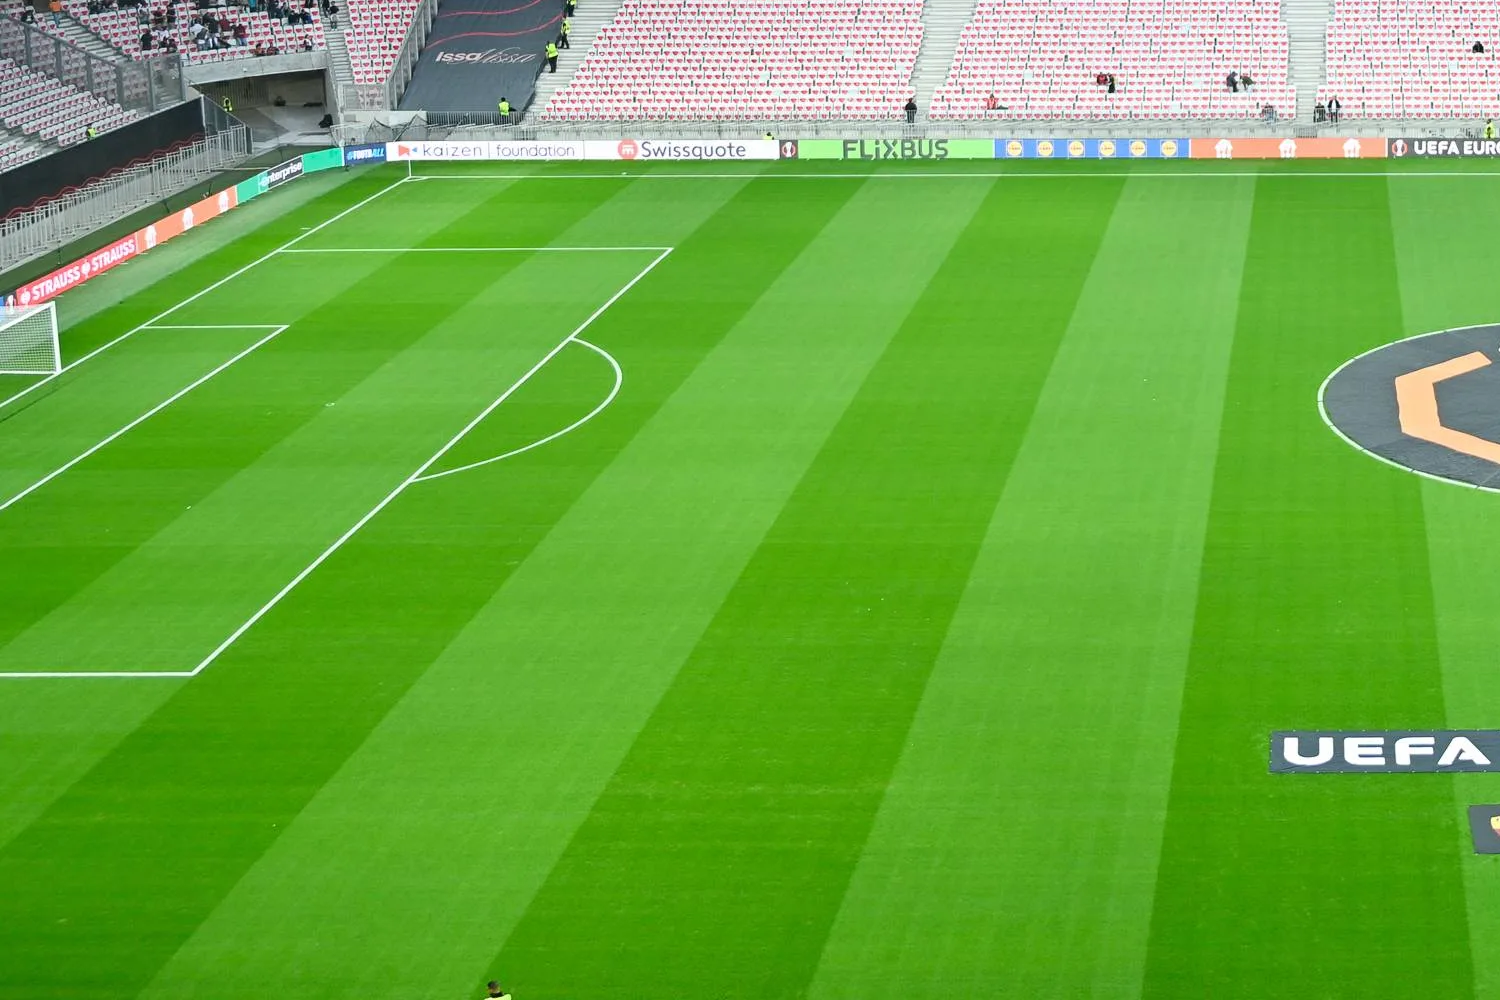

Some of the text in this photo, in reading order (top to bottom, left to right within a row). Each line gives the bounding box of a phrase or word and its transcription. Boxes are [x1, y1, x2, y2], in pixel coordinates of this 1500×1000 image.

[423, 143, 574, 158] kaizen foundation
[642, 141, 746, 160] Swissquote
[1415, 140, 1459, 155] UEFA
[92, 239, 135, 272] STRAUSS
[32, 267, 80, 301] STRAUSS
[1283, 736, 1492, 765] UEFA
